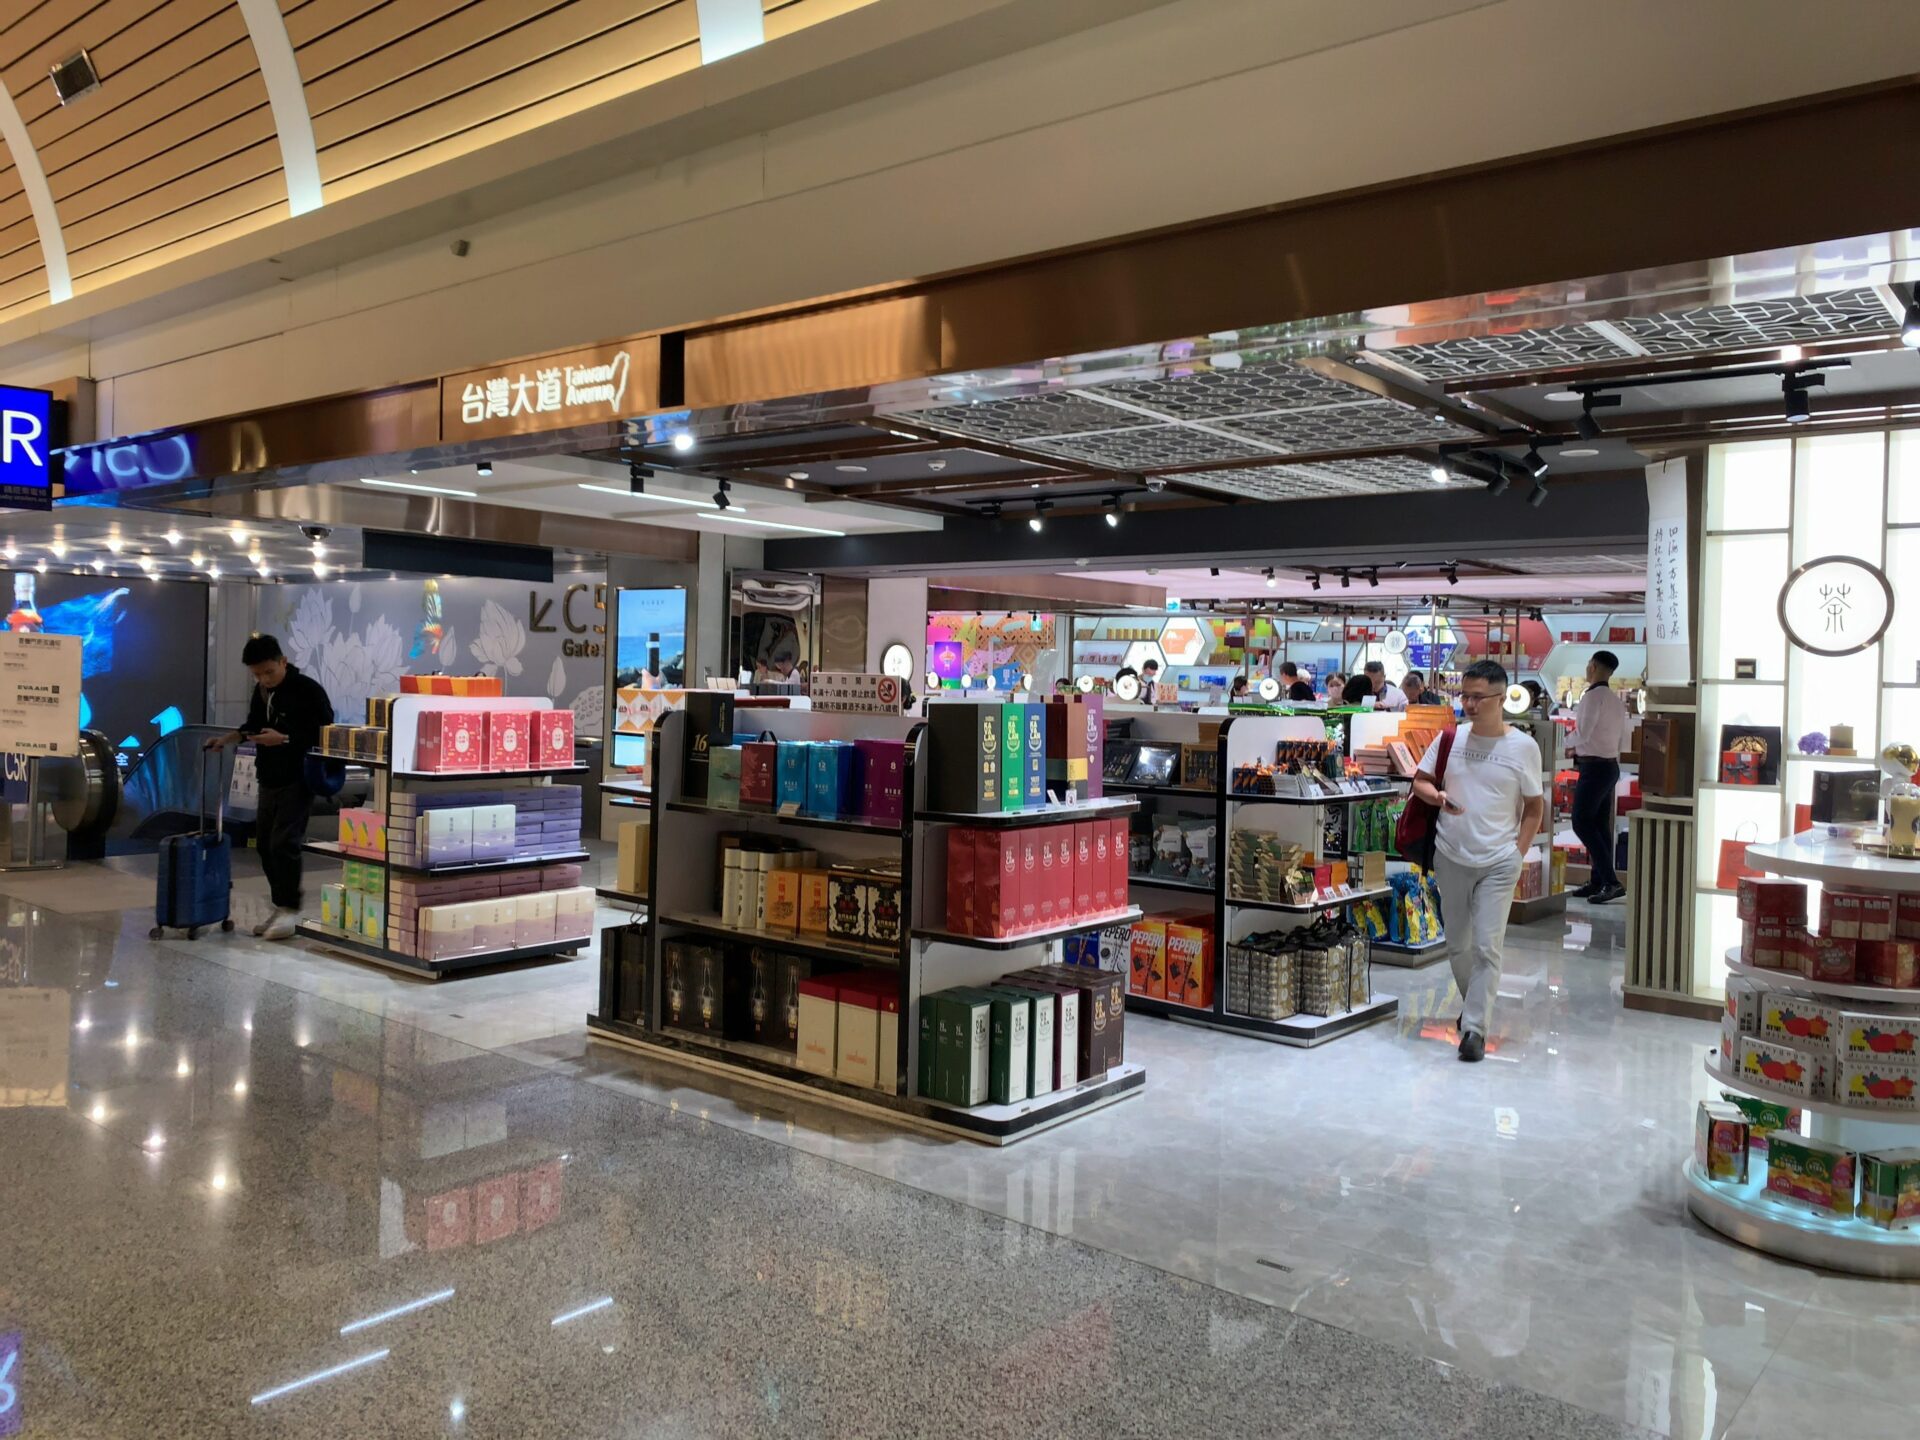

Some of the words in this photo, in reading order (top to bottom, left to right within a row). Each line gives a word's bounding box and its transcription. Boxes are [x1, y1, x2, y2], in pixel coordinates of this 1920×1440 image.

[565, 365, 612, 386] Taiwan
[461, 368, 562, 424] 台灣大道
[566, 383, 615, 406] Avenue
[3, 410, 43, 467] R
[562, 638, 600, 658] Gate
[694, 734, 709, 752] 16
[1131, 929, 1164, 947] PEPERO
[1168, 935, 1202, 955] PEPERO
